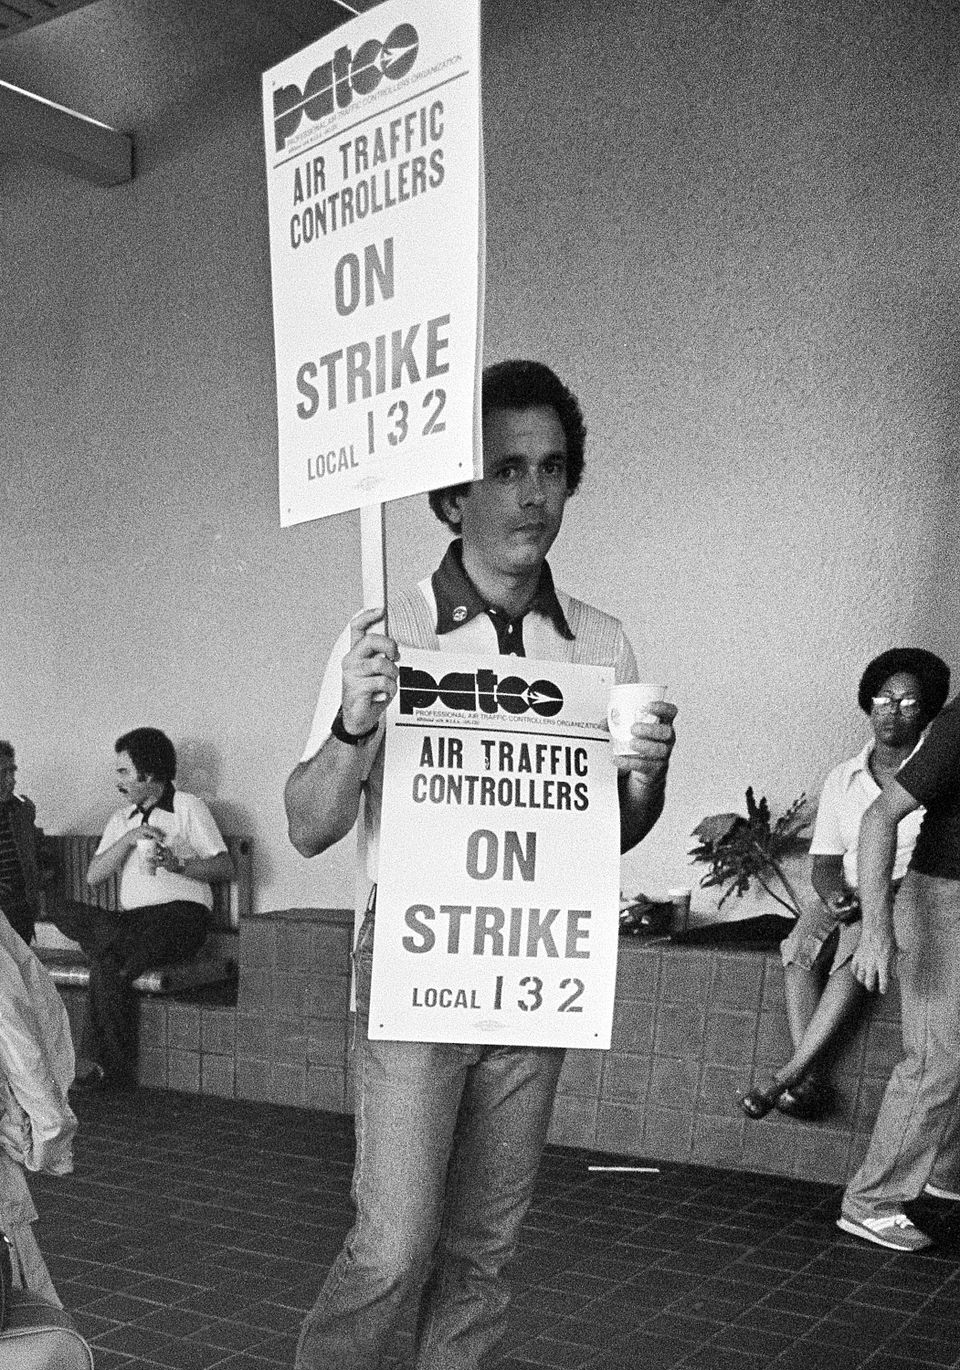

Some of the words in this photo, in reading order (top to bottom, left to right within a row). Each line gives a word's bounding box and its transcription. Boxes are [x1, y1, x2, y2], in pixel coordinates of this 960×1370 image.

[273, 23, 419, 153] patco
[293, 156, 326, 206] AIR
[339, 100, 444, 180] TRAFFIC
[290, 149, 445, 249] CONTROLLERS
[334, 237, 394, 316] ON
[296, 313, 451, 420] STRIKE
[307, 444, 359, 481] LOCAL
[399, 666, 564, 718] patco
[419, 736, 463, 769] AIR
[481, 739, 588, 777] TRAFFIC
[412, 773, 589, 811] CONTROLLERS
[466, 829, 537, 882] ON
[402, 904, 592, 959] STRIKE
[412, 988, 481, 1009] LOCAL
